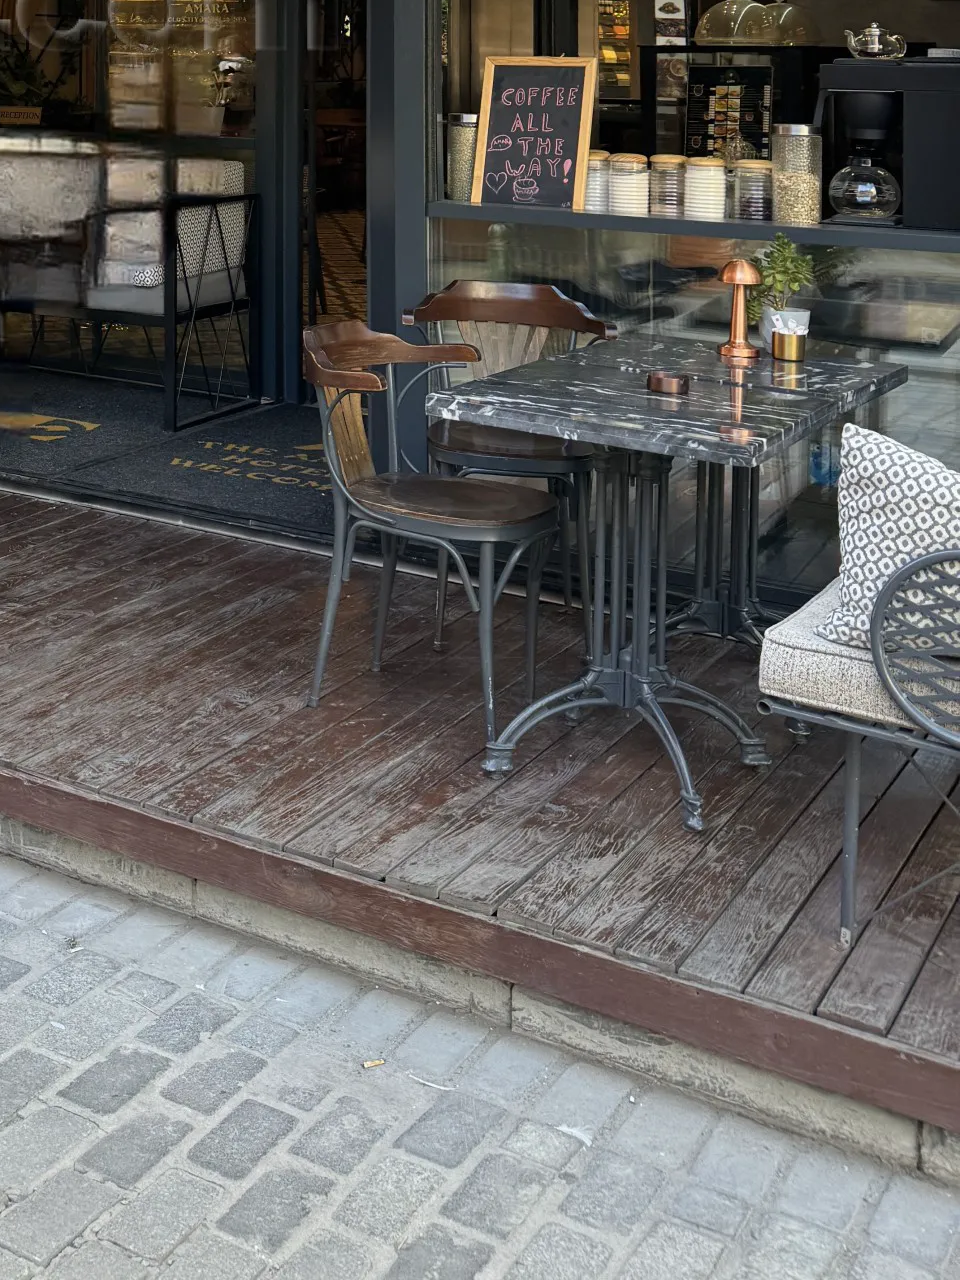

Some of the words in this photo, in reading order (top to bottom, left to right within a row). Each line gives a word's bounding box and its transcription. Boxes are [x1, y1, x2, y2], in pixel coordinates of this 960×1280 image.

[184, 3, 230, 14] AMARA
[501, 86, 579, 107] COFFEE
[0, 111, 41, 120] RECEPTION
[511, 112, 553, 133] ALL
[517, 136, 565, 157] THE
[505, 156, 573, 185] WAY!
[196, 441, 279, 455] THE
[169, 457, 333, 490] WELCOM
[221, 455, 331, 477] HOTE
